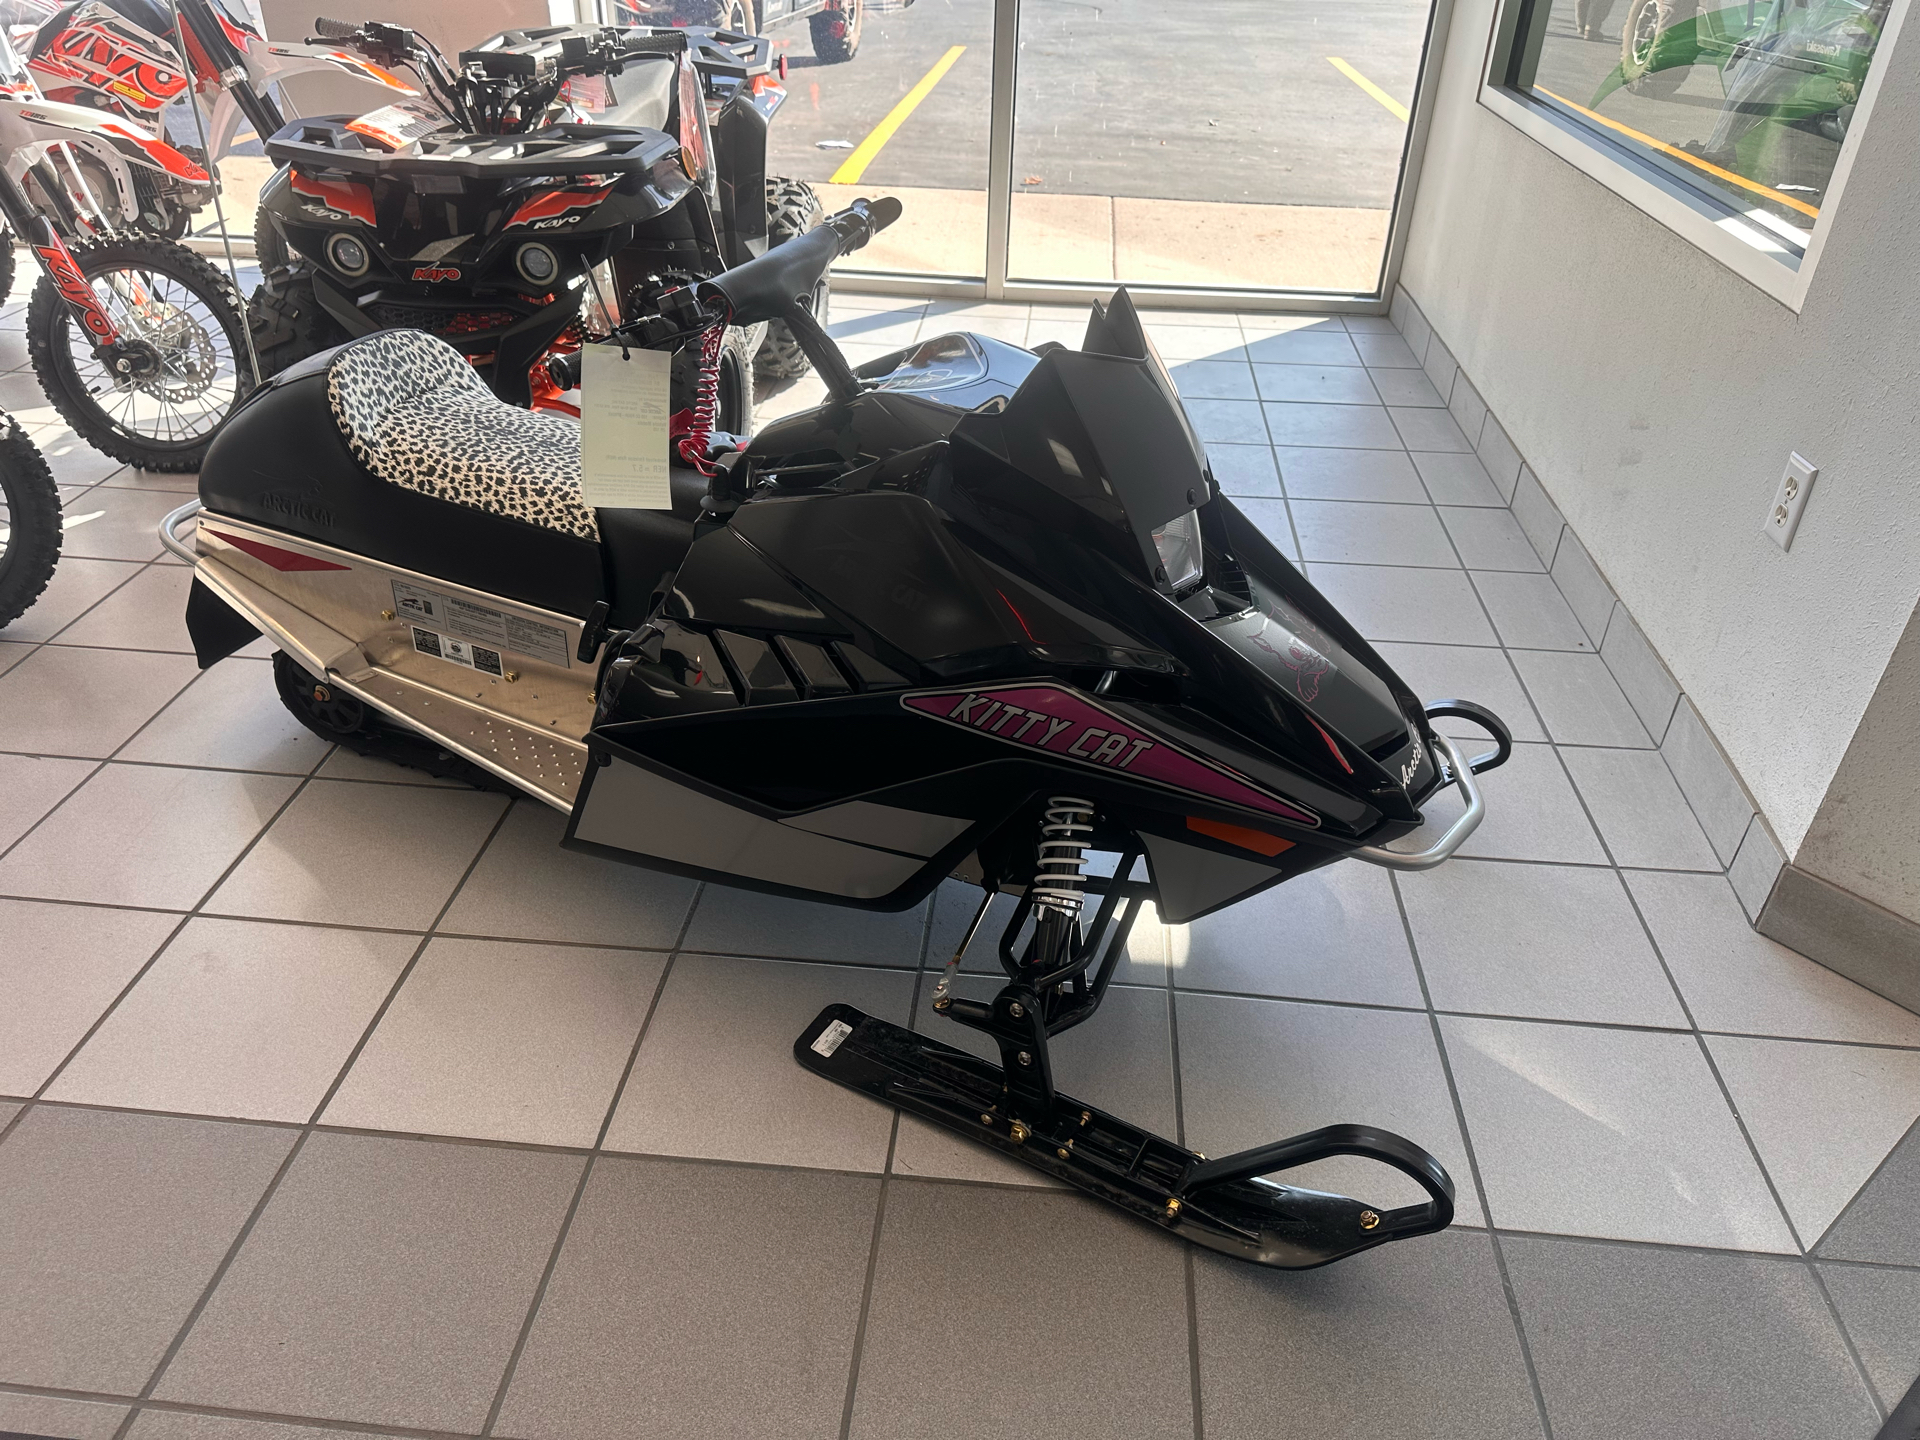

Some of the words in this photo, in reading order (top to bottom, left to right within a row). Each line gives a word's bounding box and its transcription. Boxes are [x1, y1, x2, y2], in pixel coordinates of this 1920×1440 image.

[32, 243, 112, 336] KAYO
[412, 261, 462, 284] KAYO
[262, 491, 309, 521] ARCTIC
[312, 506, 337, 528] CAT
[949, 693, 1075, 747] KITTY
[1067, 727, 1155, 768] CAT
